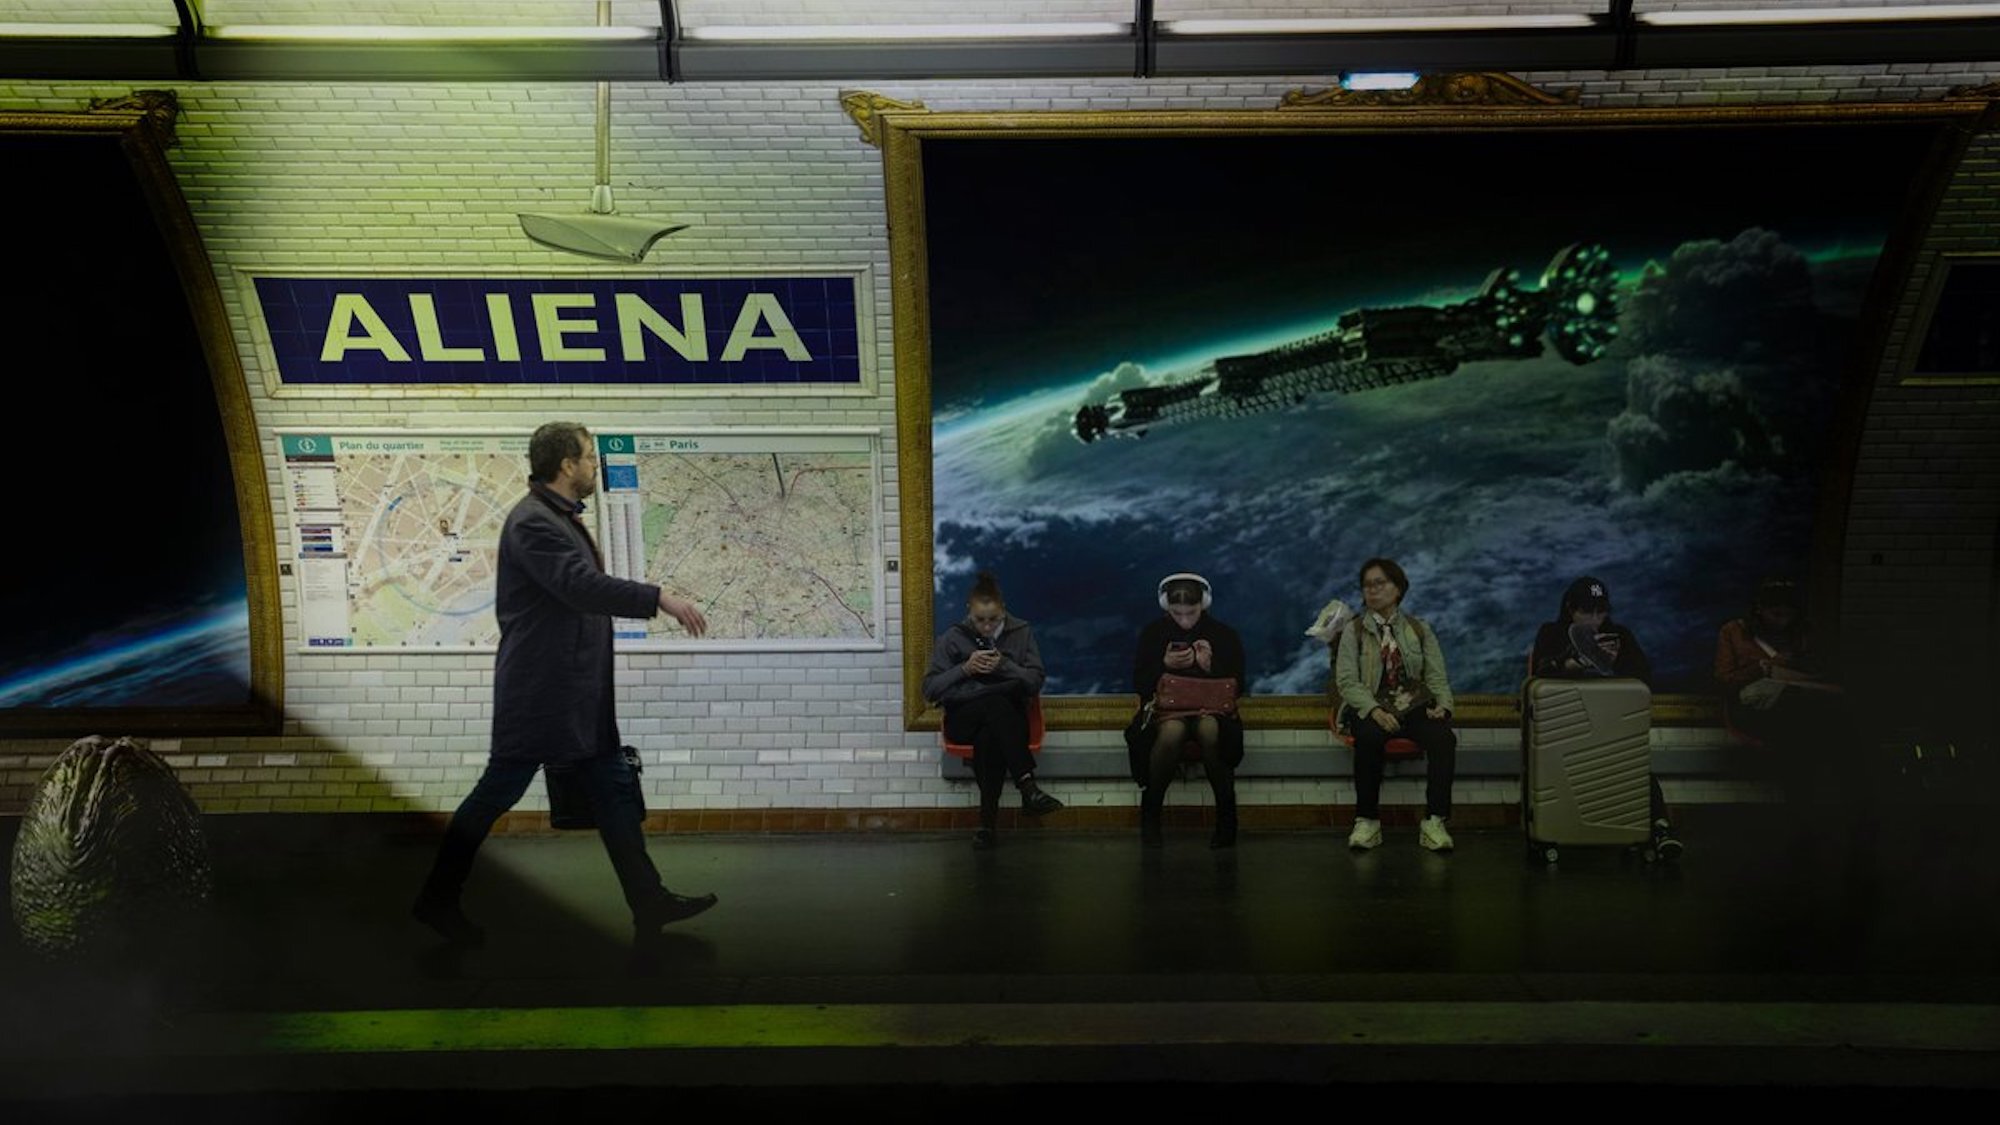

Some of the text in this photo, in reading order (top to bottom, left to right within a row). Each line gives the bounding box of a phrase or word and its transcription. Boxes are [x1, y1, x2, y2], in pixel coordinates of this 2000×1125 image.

[320, 293, 812, 361] ALIENA
[339, 440, 424, 452] Plan du quartier
[670, 438, 699, 449] Paris
